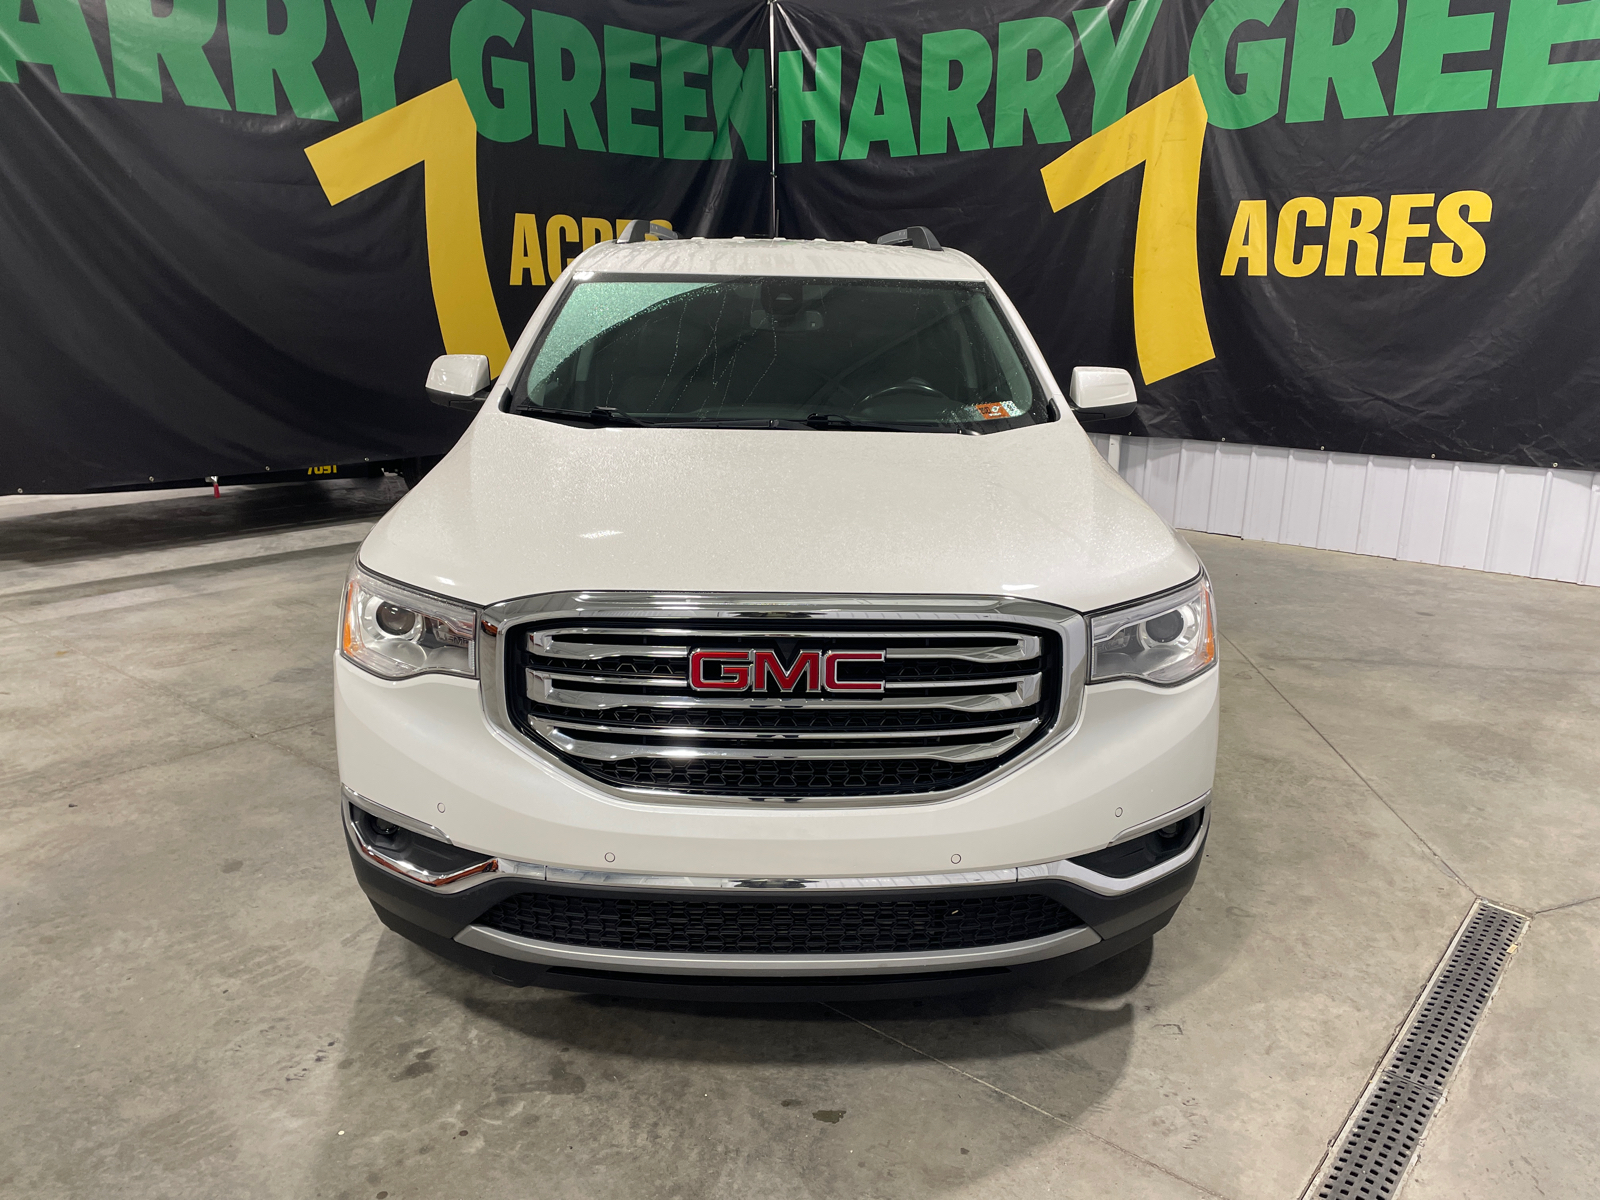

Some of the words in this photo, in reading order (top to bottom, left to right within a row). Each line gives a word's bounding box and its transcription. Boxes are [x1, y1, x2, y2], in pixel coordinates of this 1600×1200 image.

[450, 0, 767, 161] GREEN
[778, 0, 1162, 164] HARRY
[305, 79, 511, 381] 7
[1041, 75, 1216, 385] 7
[1221, 190, 1493, 278] ACRES
[689, 648, 886, 692] GMC
